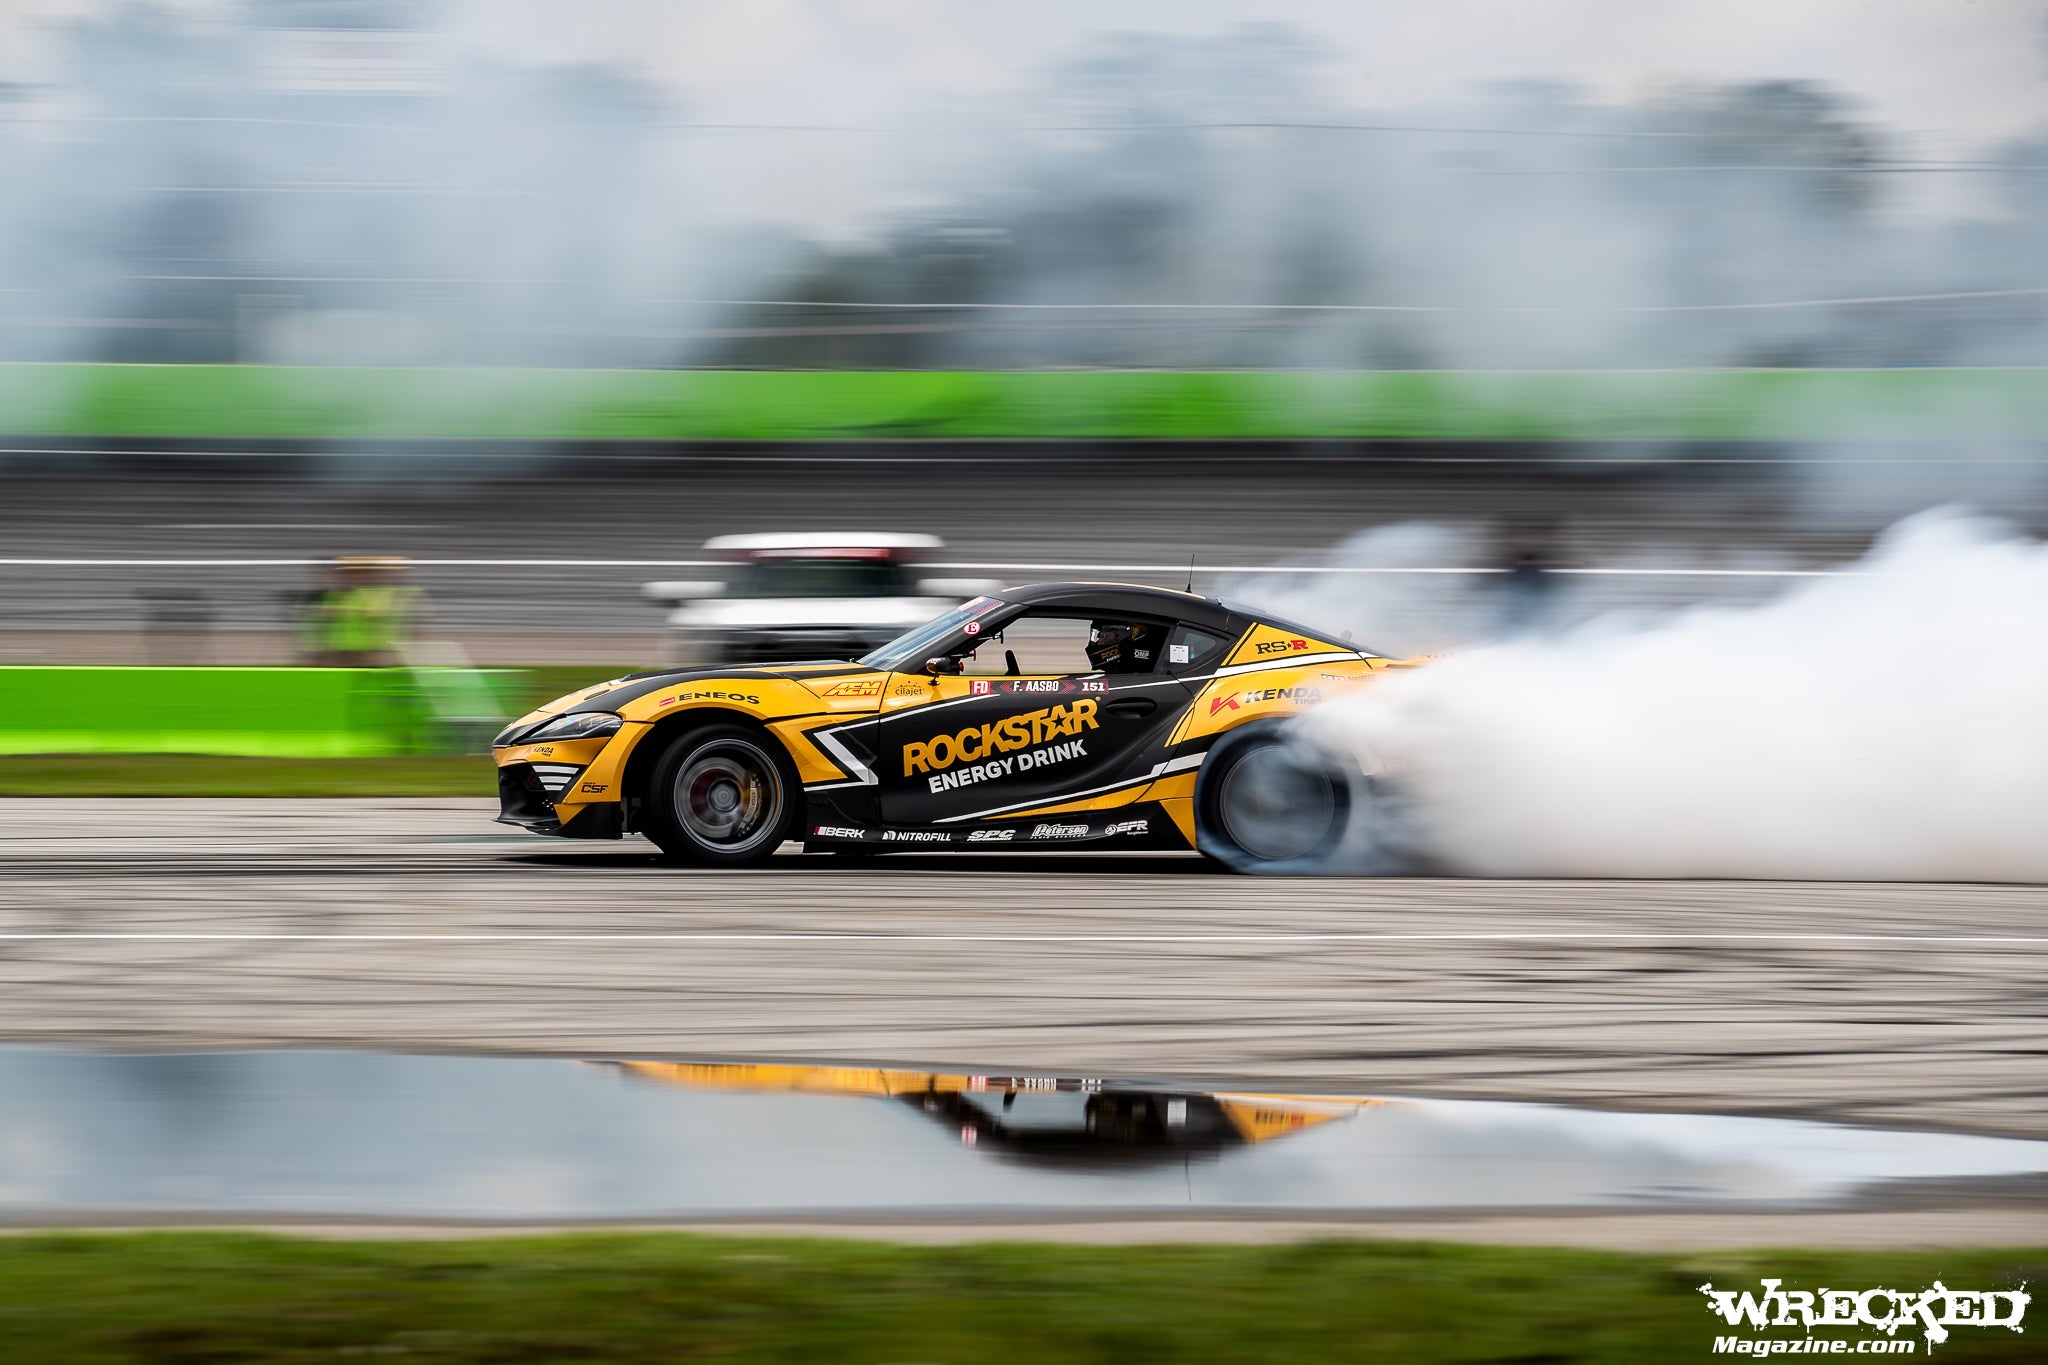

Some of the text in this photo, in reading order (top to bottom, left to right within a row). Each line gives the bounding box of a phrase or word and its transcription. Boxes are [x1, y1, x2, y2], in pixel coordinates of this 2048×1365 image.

[822, 681, 883, 696] AEM
[895, 687, 923, 696] cilajet
[1025, 681, 1059, 692] AASBO
[1081, 682, 1105, 692] 151
[678, 691, 760, 705] ENEOS
[1245, 687, 1322, 704] KENDA
[903, 698, 1100, 777] ROCKSTAR
[928, 739, 1087, 794] ENERGY DRINK
[581, 784, 609, 793] CSF
[826, 827, 865, 838] BERK
[896, 831, 951, 841] NITROFILL
